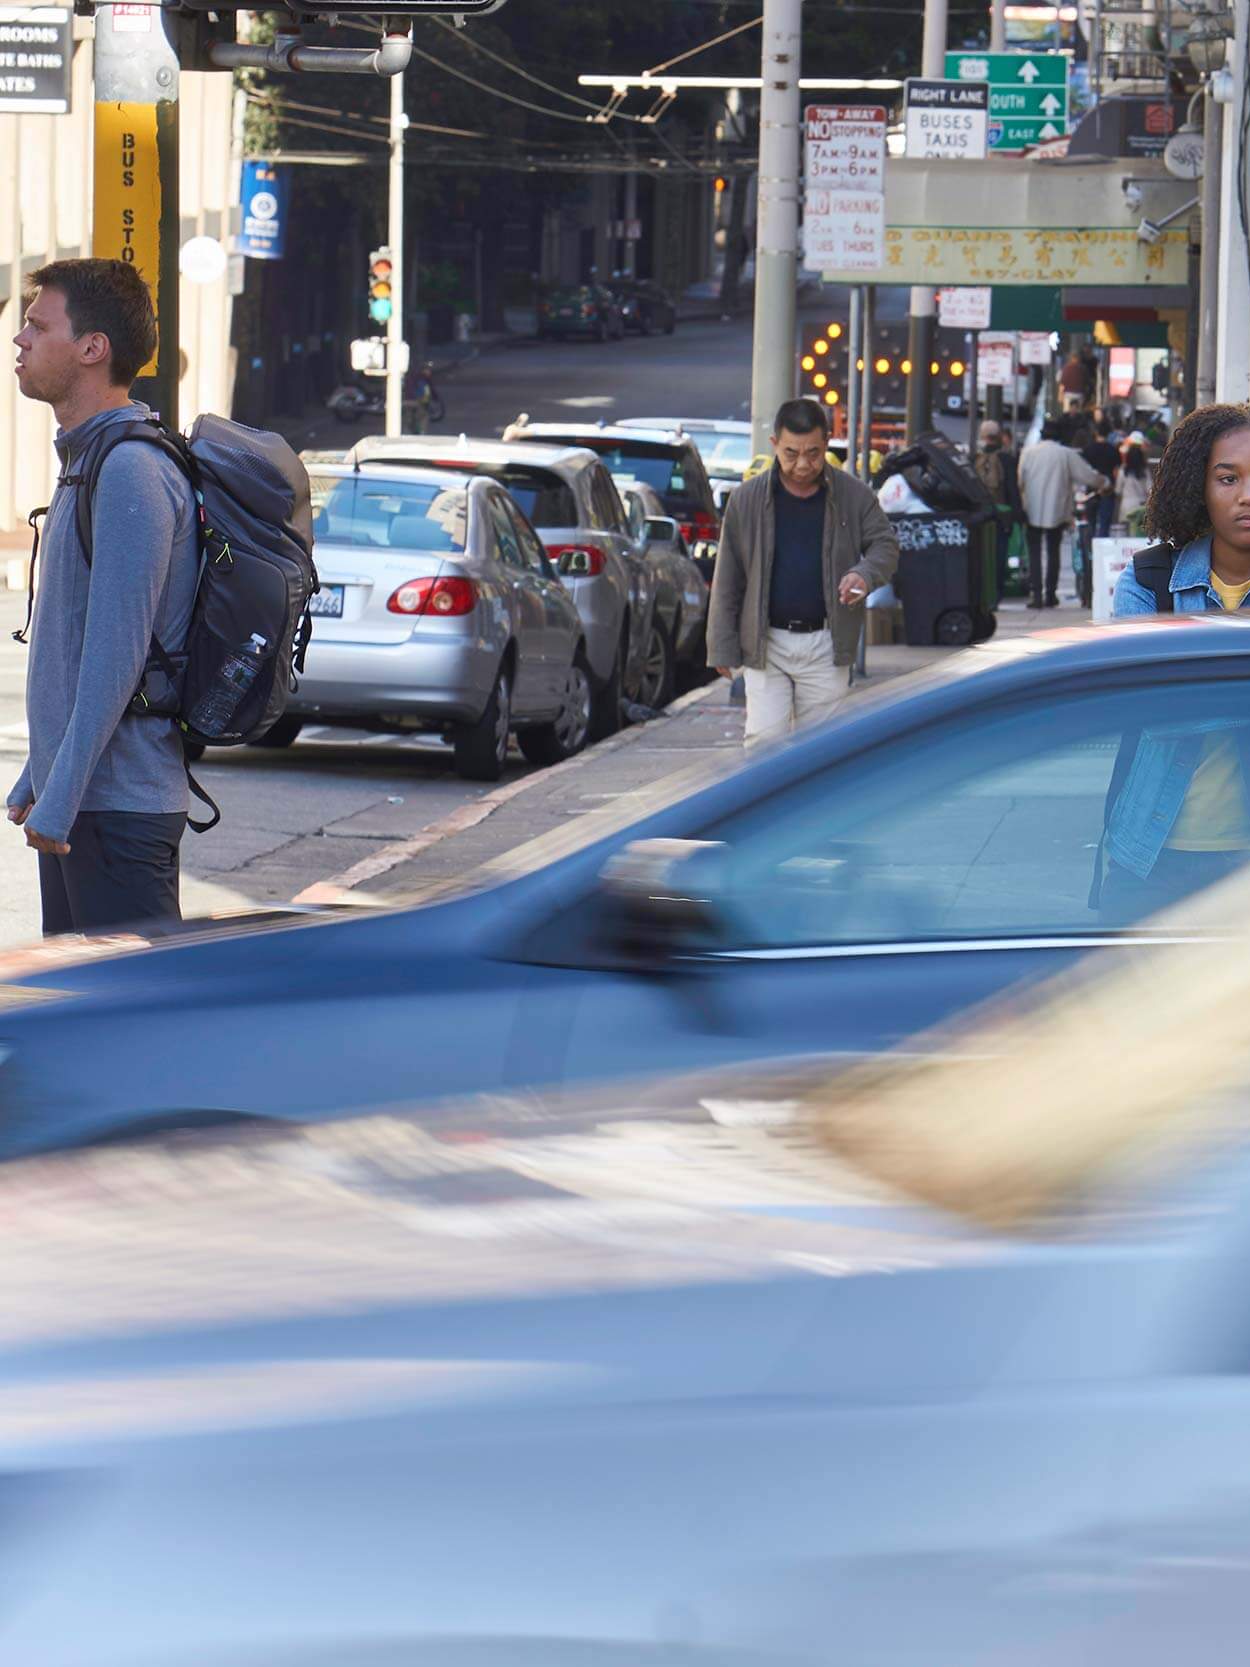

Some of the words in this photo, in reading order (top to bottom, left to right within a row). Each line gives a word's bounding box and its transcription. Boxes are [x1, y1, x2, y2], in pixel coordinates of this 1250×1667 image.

[910, 87, 946, 102] RIGHT
[950, 90, 985, 104] LANE
[990, 94, 1025, 110] OUTH
[816, 108, 876, 120] TOW-AWAY
[920, 113, 972, 130] BUSES
[807, 121, 830, 138] NO
[832, 125, 883, 138] STOPPING
[1008, 129, 1034, 140] EAST
[925, 132, 967, 148] TAXIS
[122, 133, 135, 187] BUS
[122, 208, 135, 263] STO
